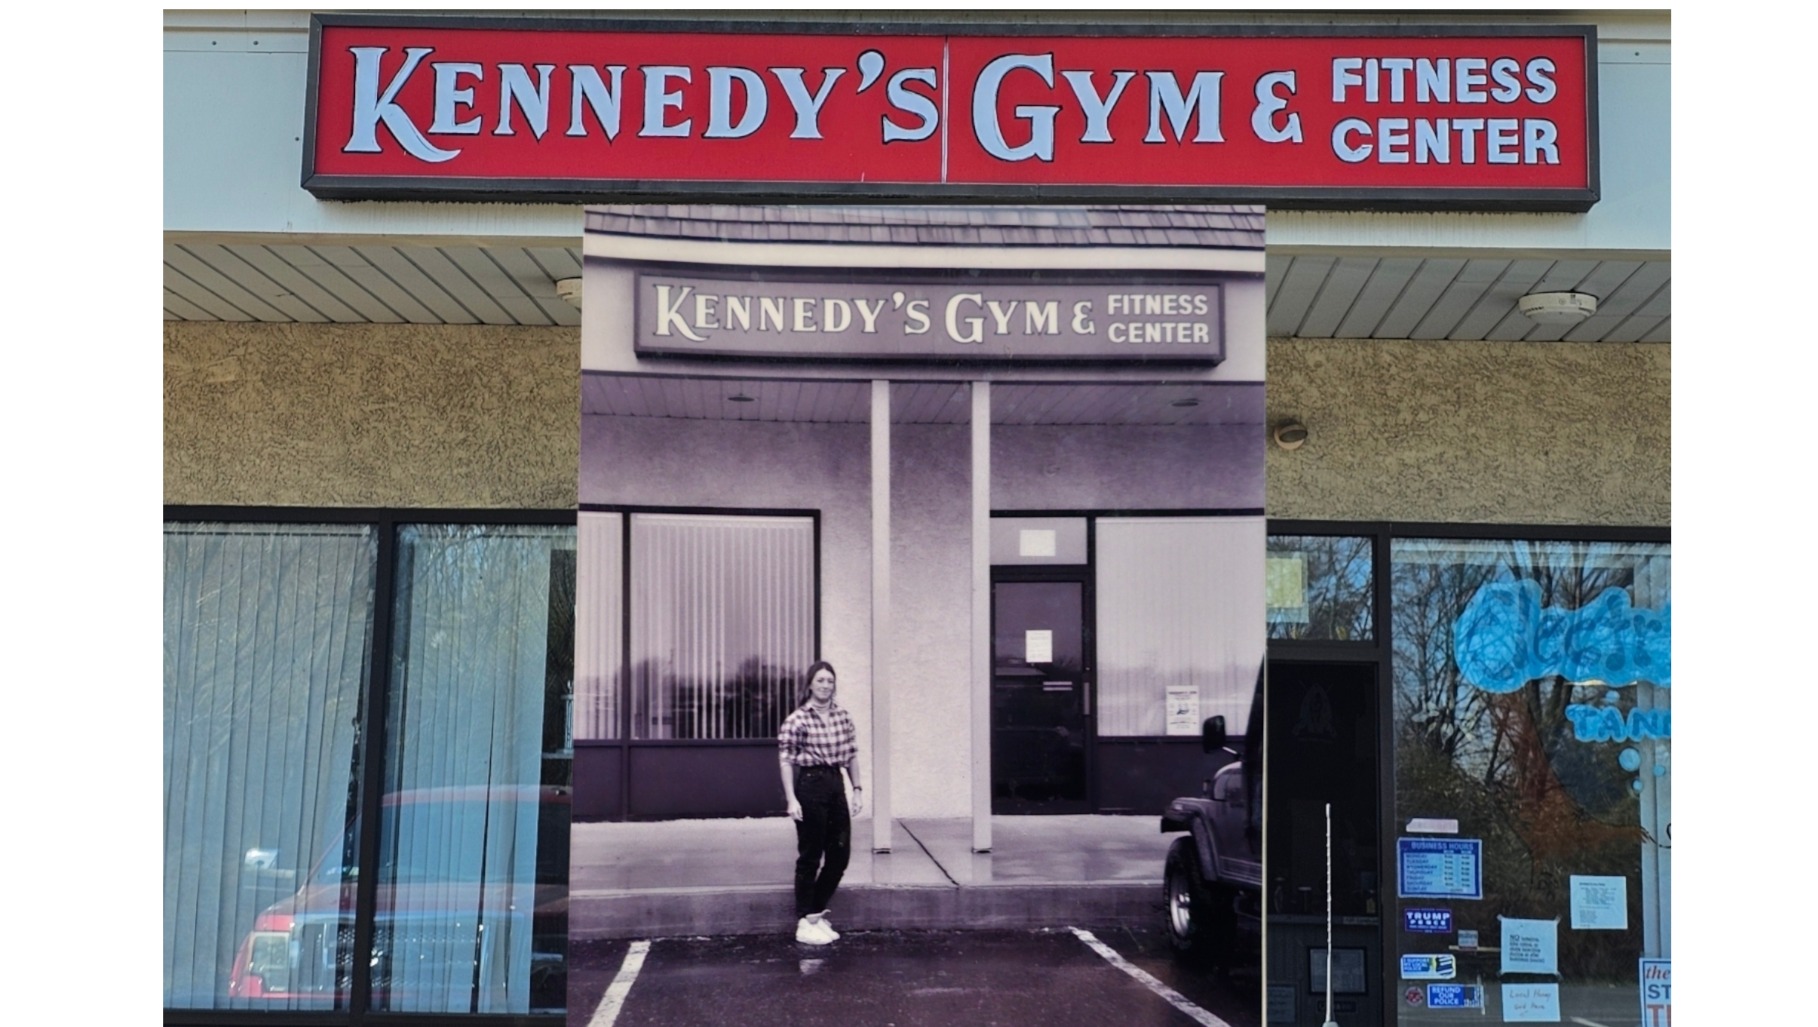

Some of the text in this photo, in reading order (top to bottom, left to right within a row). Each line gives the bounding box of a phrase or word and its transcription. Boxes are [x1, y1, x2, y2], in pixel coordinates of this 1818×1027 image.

[1331, 56, 1558, 104] FITNESS
[342, 46, 1303, 163] KENNEDY'S GYM &
[1331, 117, 1561, 165] CENTER
[652, 284, 1096, 344] KENNEDY'S GYM &
[1107, 293, 1209, 317] FITNESS
[1107, 321, 1211, 345] CENTER
[1410, 841, 1474, 851] BUSINESS HOURS
[1406, 911, 1451, 921] TRUMP
[1645, 965, 1672, 980] the
[1431, 986, 1461, 994] REFUND
[1438, 992, 1455, 1000] OUR
